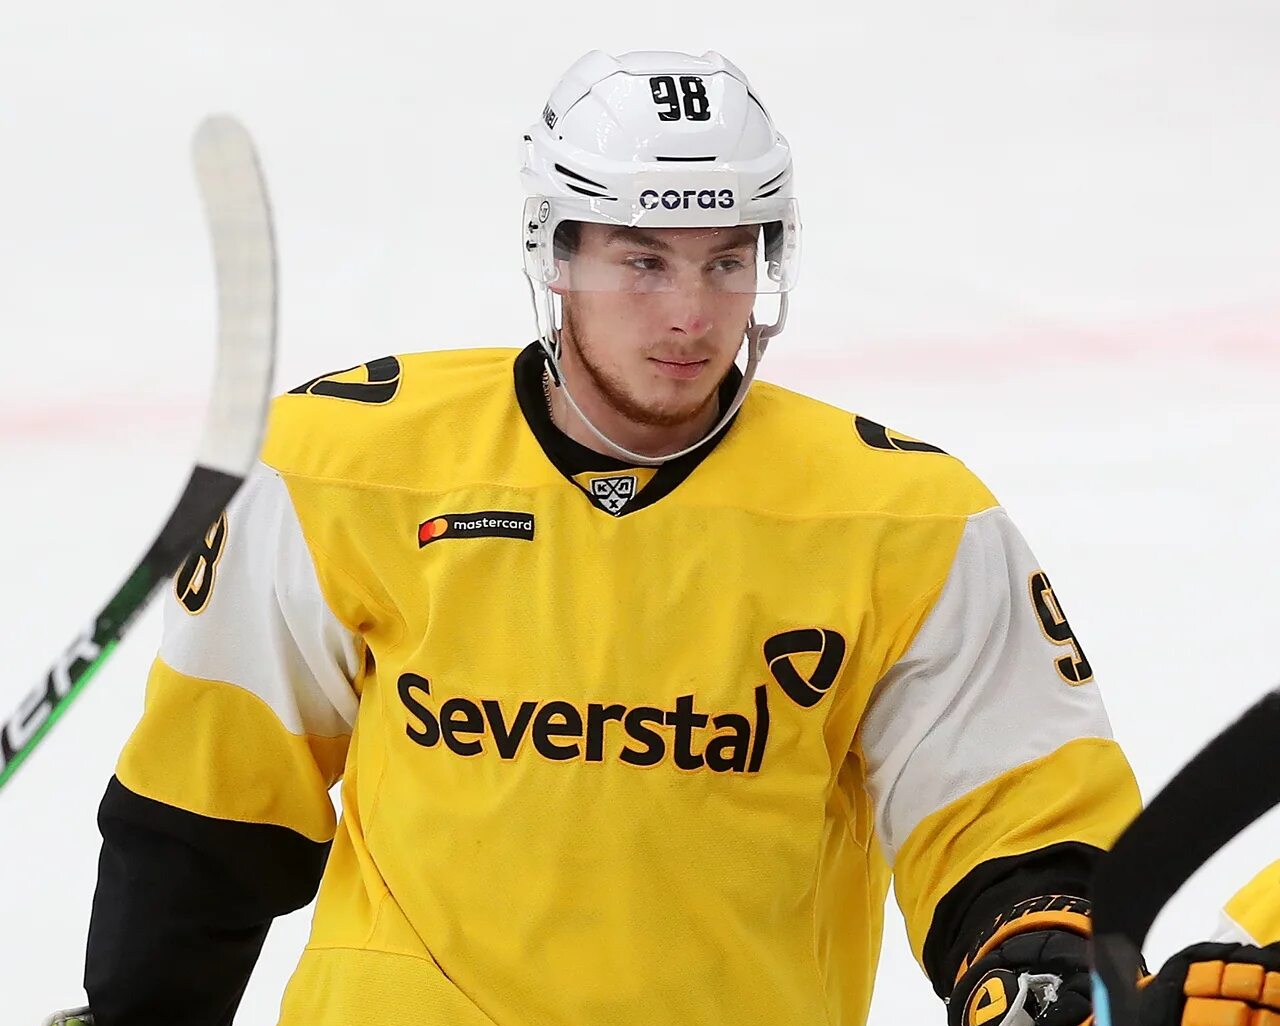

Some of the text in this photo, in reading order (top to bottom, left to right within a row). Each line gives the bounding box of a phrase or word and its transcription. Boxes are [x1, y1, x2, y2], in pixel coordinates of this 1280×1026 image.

[649, 75, 711, 121] 98
[453, 515, 533, 533] mastercard
[397, 672, 769, 773] Severstal
